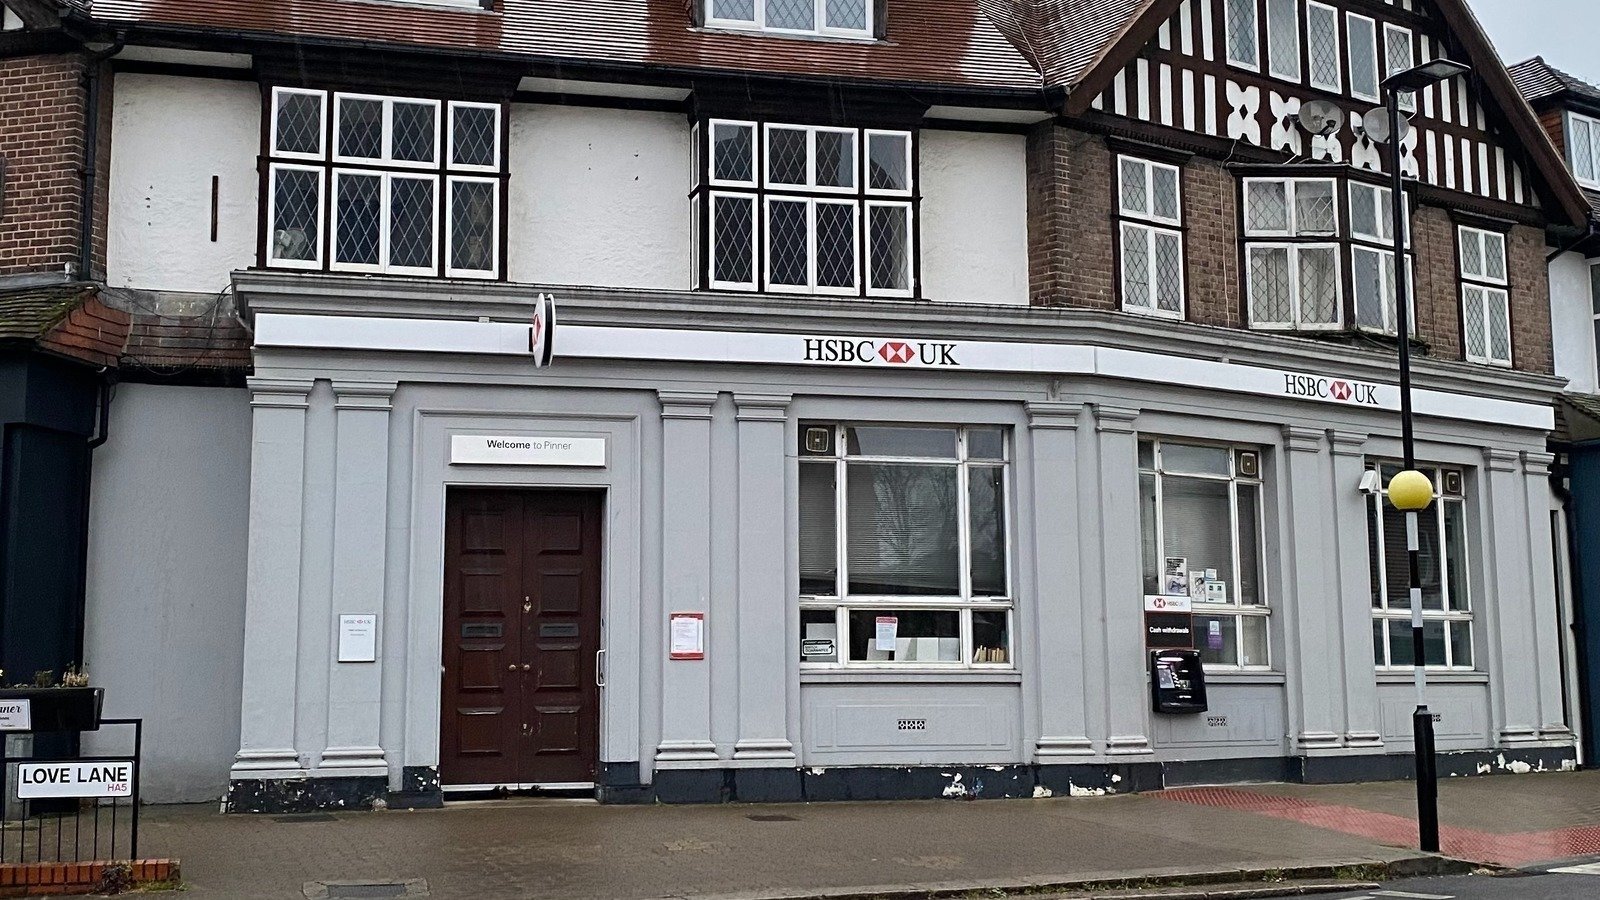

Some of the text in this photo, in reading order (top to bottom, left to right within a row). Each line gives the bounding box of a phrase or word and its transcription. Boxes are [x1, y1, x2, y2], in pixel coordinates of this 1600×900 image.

[803, 338, 960, 366] HSBC UK
[1283, 373, 1379, 405] HSBC UK
[486, 439, 572, 450] Welcome to Pinner
[22, 766, 128, 784] LOVE LANE
[107, 783, 128, 792] HA5
